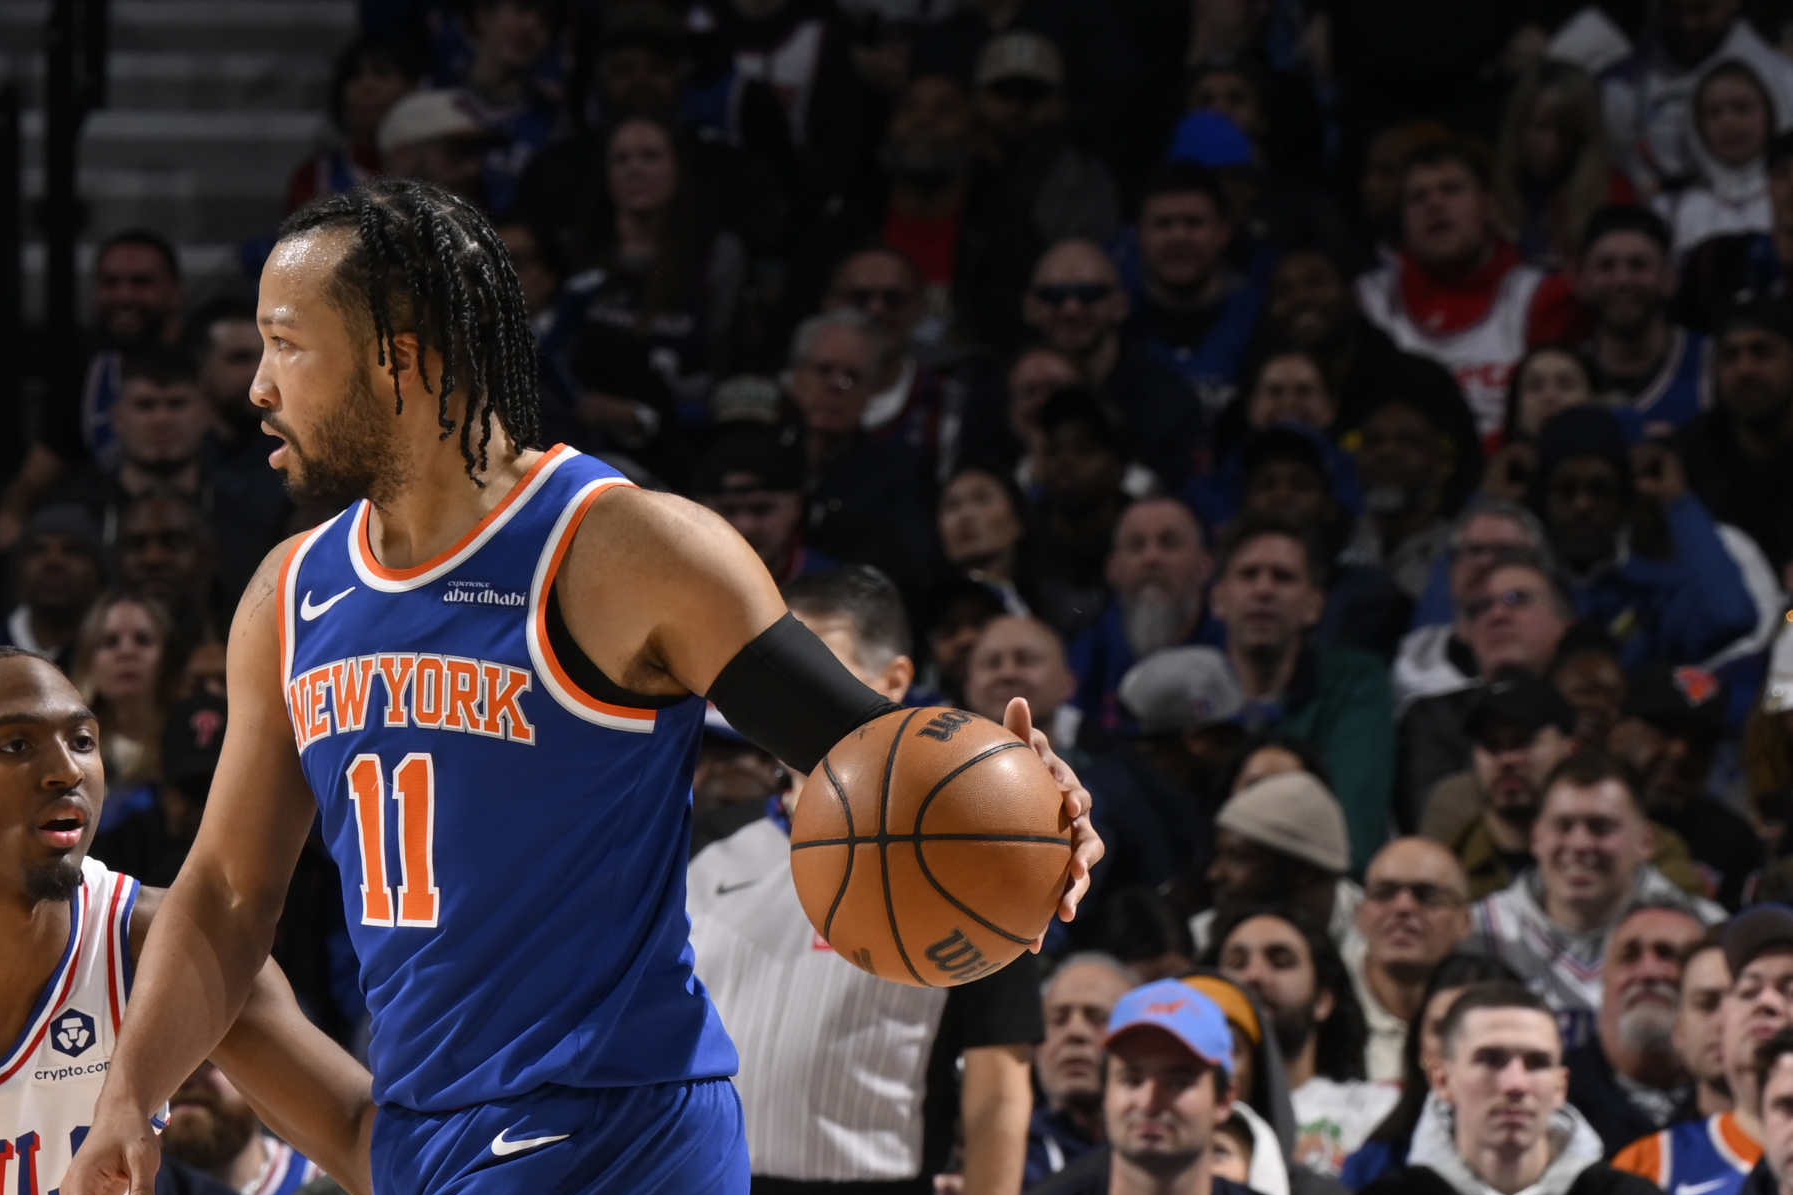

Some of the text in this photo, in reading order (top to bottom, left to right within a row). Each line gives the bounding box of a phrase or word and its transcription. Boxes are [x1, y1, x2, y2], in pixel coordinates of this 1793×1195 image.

[443, 588, 527, 606] abu dhabi
[447, 580, 491, 588] experience
[289, 652, 536, 757] NEW YORK
[346, 753, 440, 928] 11
[924, 926, 1002, 982] Wil
